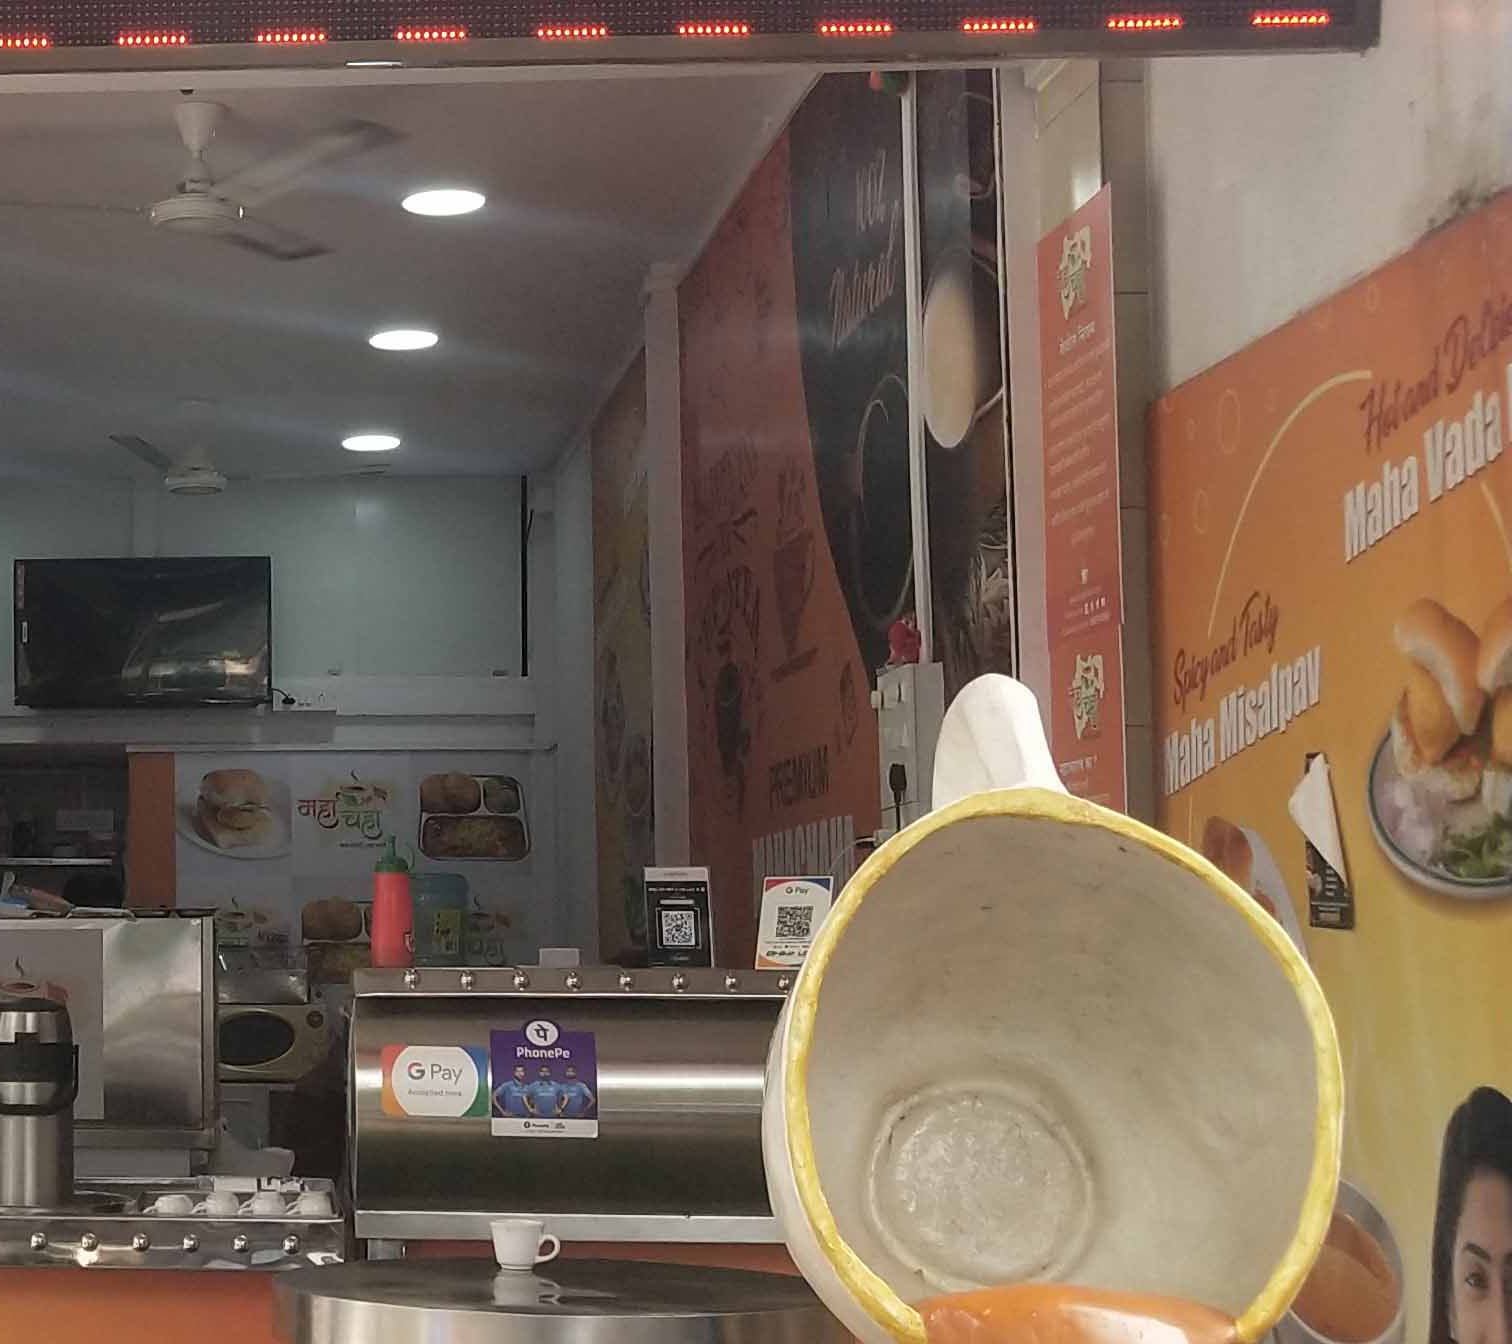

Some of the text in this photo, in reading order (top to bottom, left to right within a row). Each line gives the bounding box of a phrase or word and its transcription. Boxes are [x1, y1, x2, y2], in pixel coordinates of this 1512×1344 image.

[1359, 378, 1401, 453] Hot
[1402, 345, 1439, 423] and
[1343, 455, 1420, 564] Maha
[1423, 389, 1504, 504] Vada
[1173, 648, 1209, 713] Spicy
[1210, 615, 1238, 676] and
[1239, 591, 1279, 655] Tasty
[1163, 716, 1216, 797] Maha
[1218, 645, 1322, 763] Misalpav
[768, 743, 831, 810] PREMIUM
[296, 799, 339, 829] महा
[339, 809, 383, 840] चहा
[430, 1063, 463, 1085] Pay
[516, 1047, 571, 1060] PhonePe
